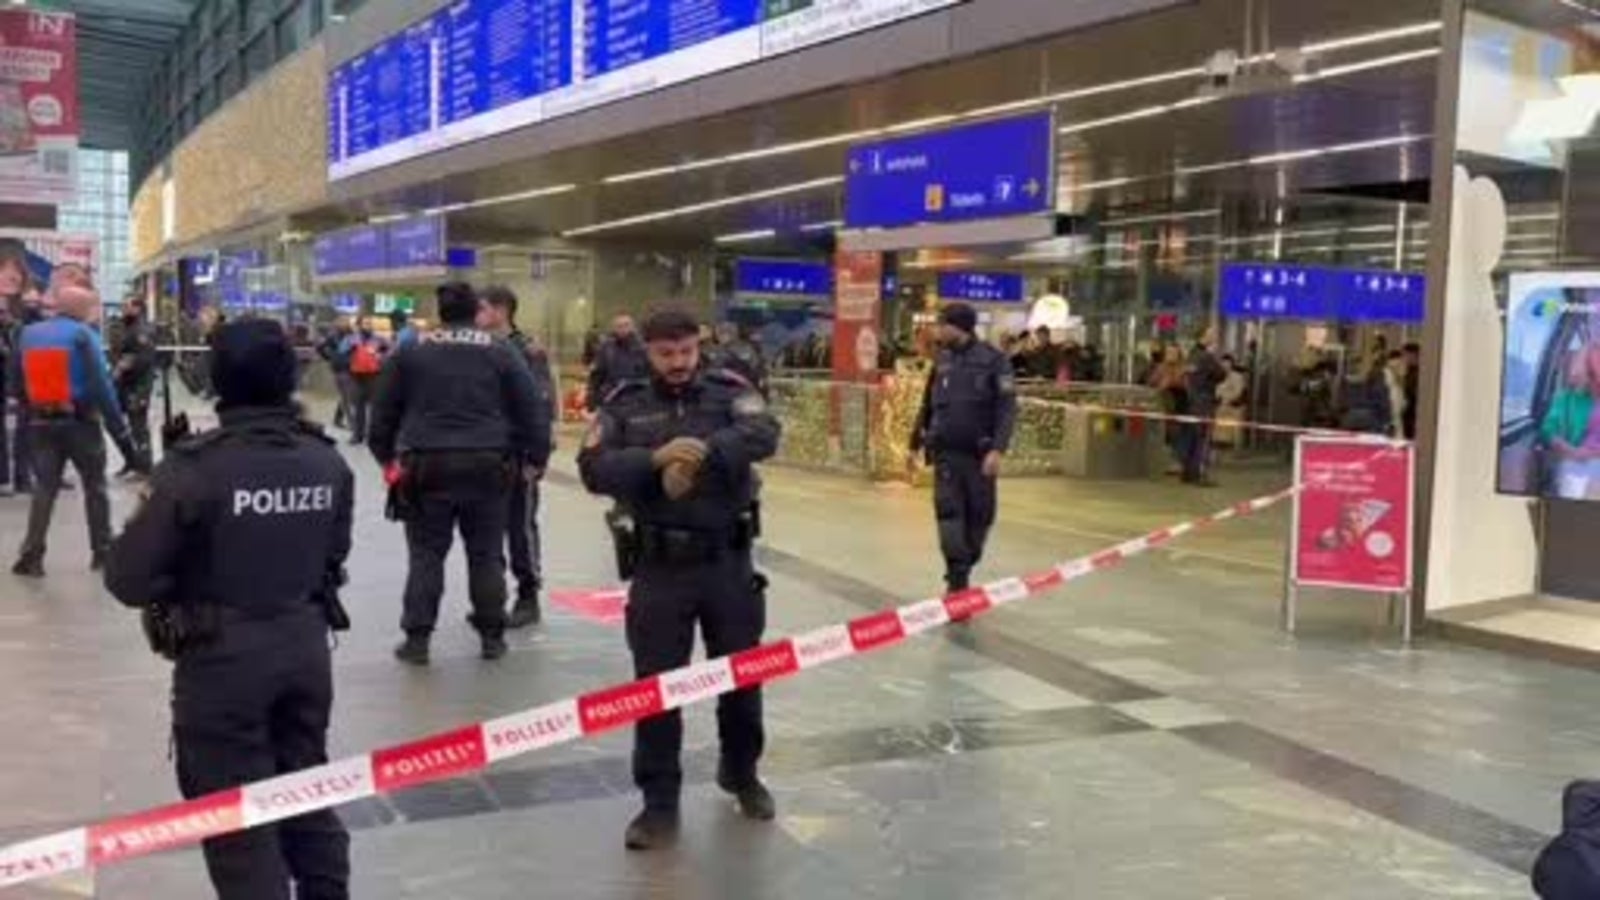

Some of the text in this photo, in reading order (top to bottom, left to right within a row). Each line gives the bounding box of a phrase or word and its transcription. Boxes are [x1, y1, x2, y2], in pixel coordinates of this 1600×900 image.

[234, 485, 332, 516] POLIZEI
[492, 713, 567, 746] POLIZEI
[383, 746, 465, 780] POLIZEI
